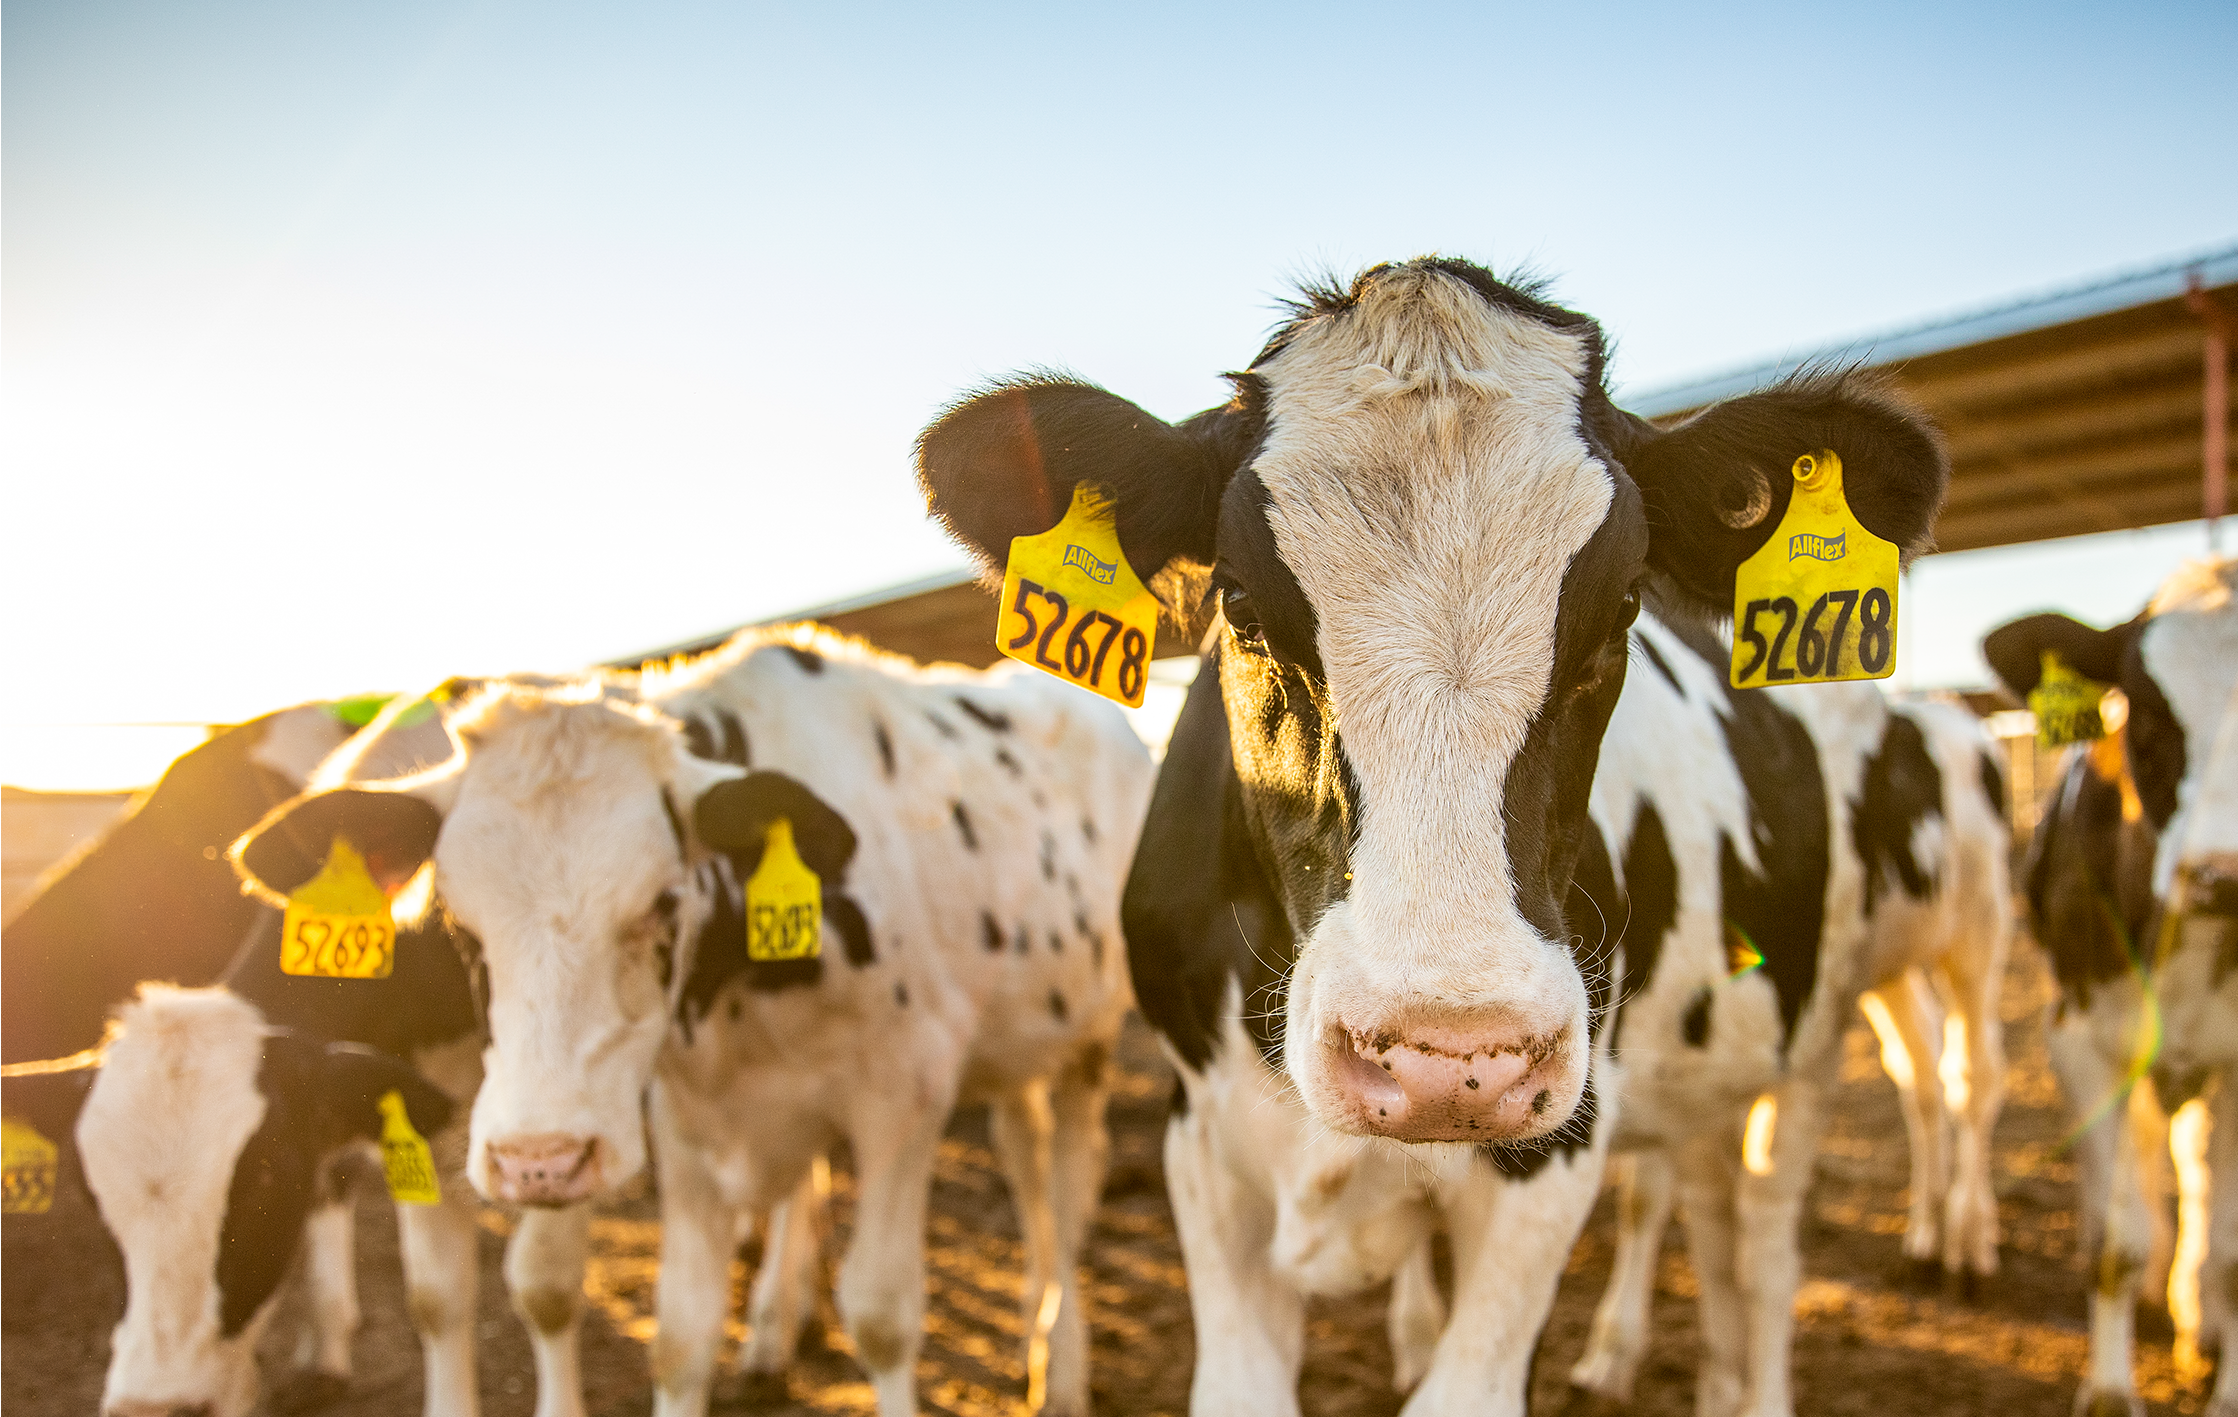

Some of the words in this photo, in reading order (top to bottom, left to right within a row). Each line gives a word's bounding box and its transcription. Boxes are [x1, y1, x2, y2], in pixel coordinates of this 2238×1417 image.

[1064, 546, 1115, 585] Allflex
[1790, 535, 1845, 561] Allflex
[1009, 578, 1147, 700] 52678
[1738, 587, 1891, 683] 52678
[293, 920, 387, 975] 52693
